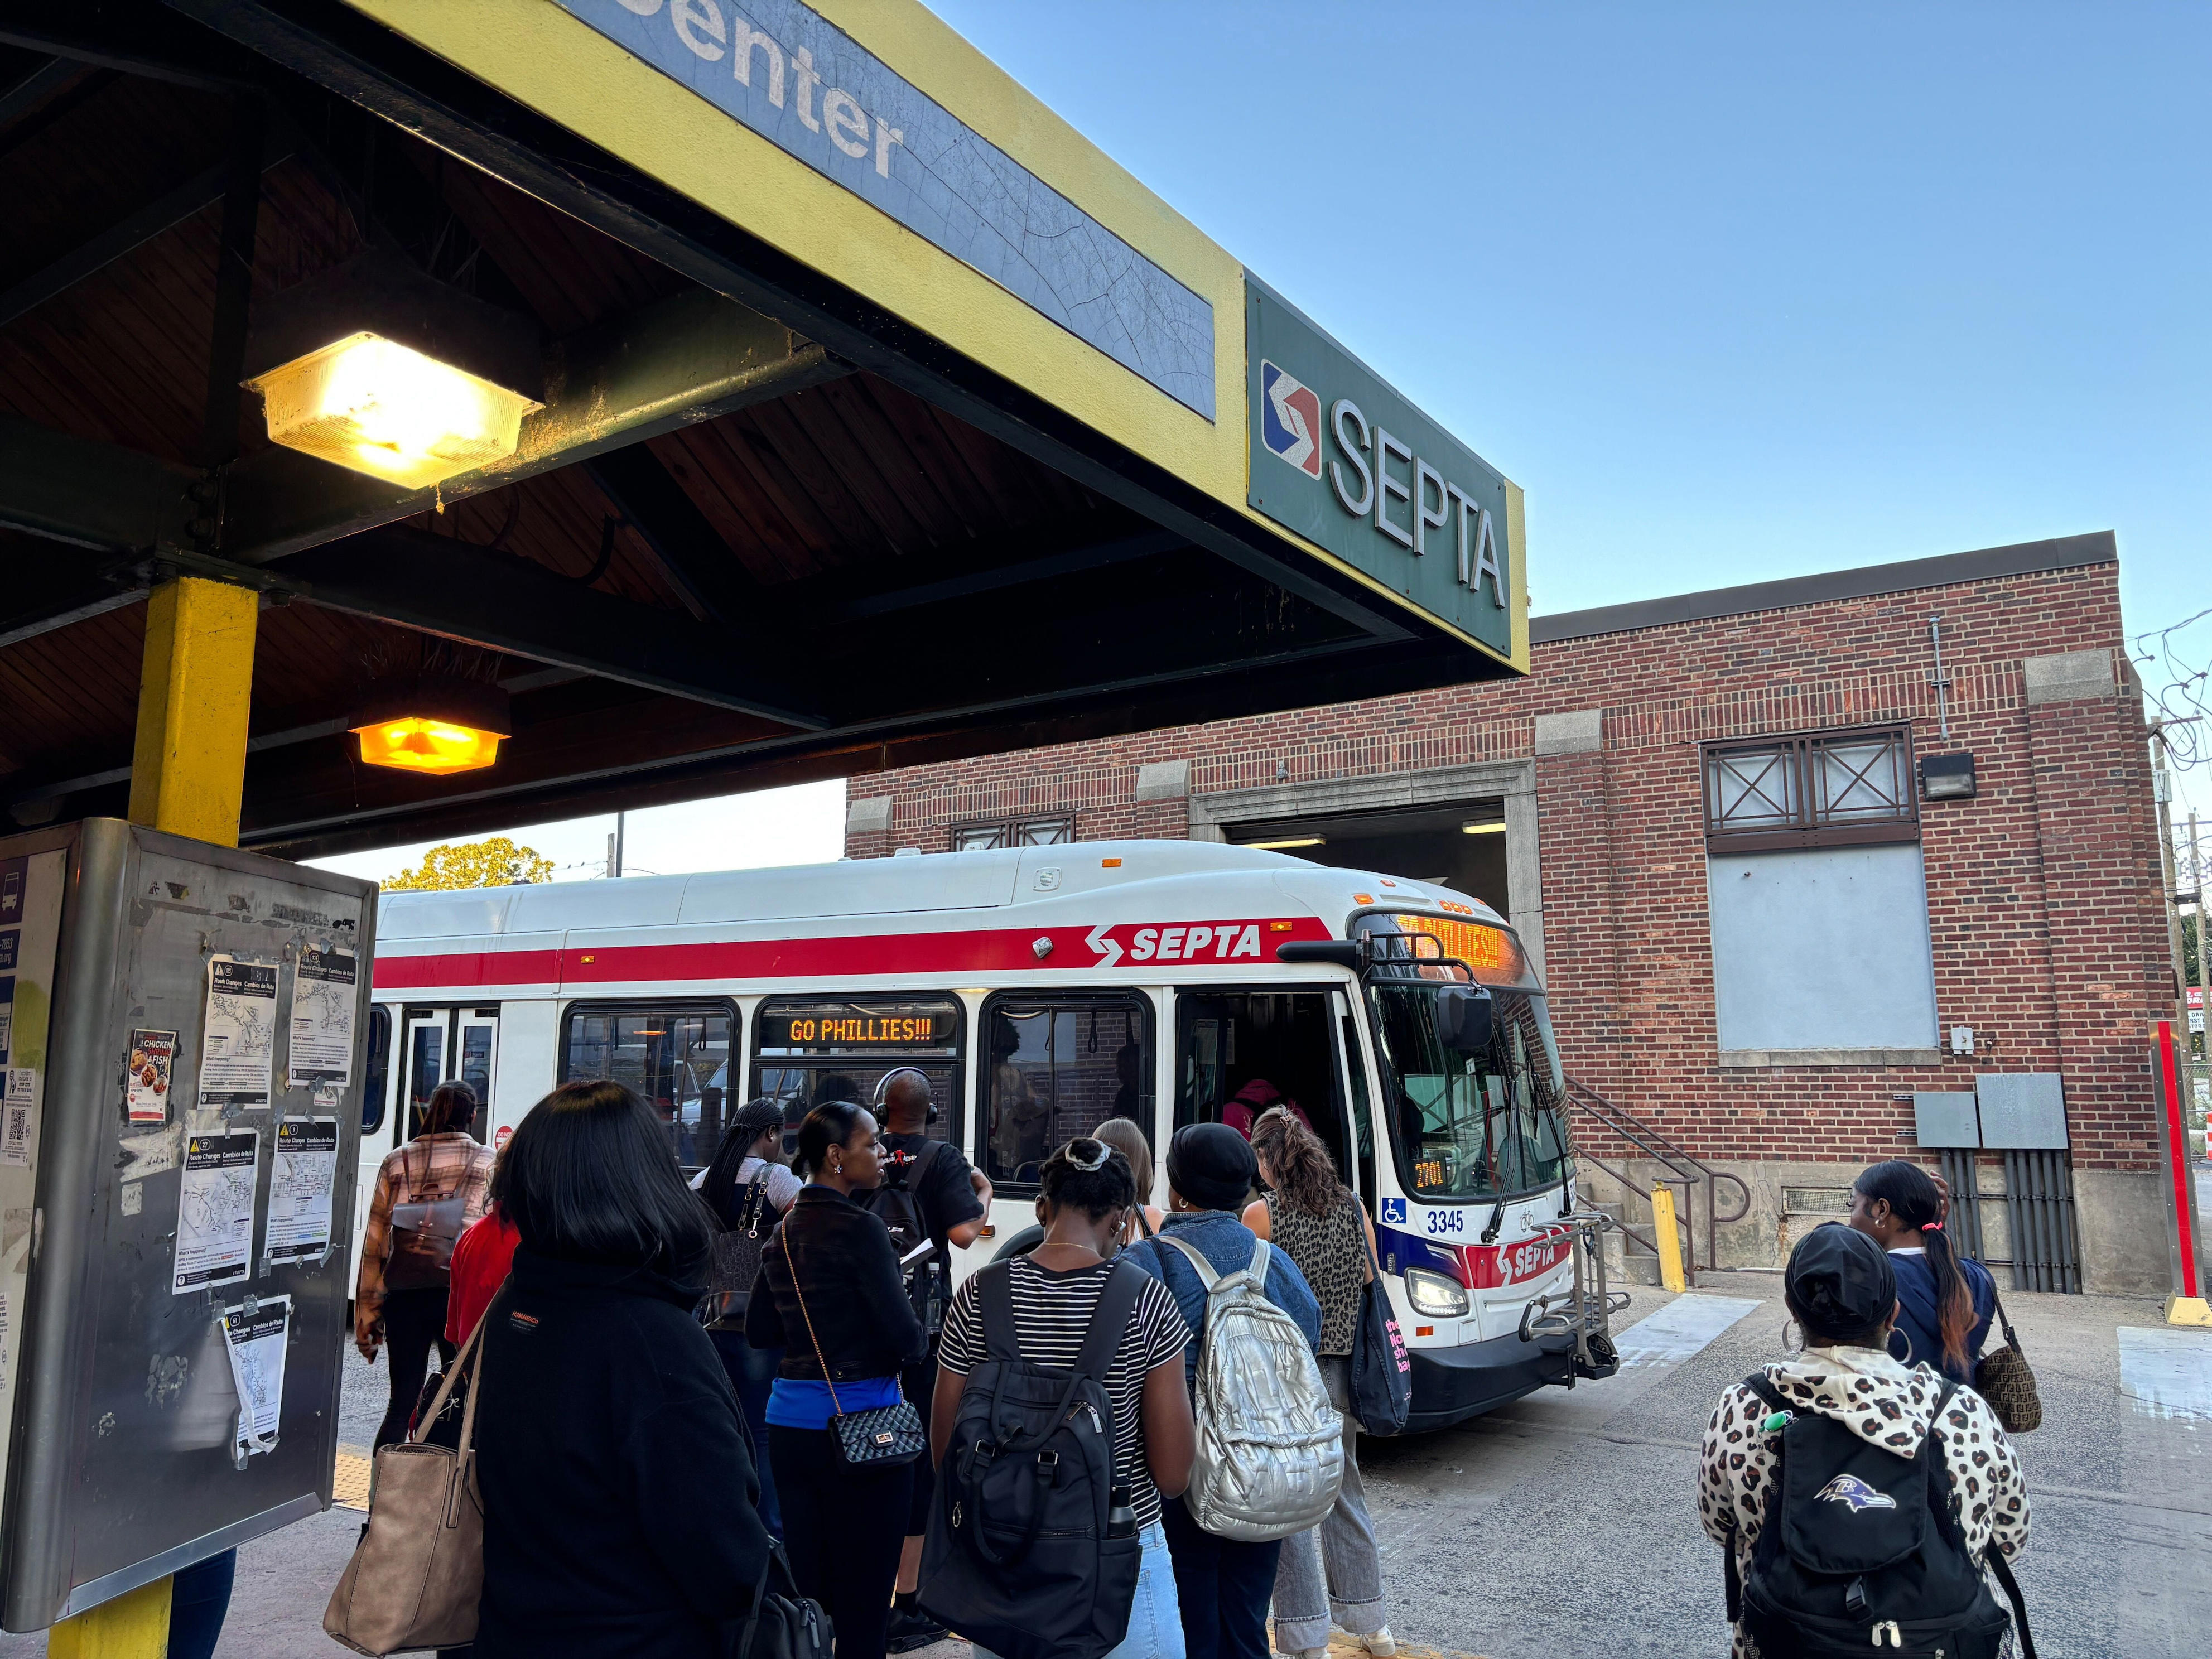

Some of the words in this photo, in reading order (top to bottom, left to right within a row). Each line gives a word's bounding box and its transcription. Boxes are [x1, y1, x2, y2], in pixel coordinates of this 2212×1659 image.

[616, 0, 904, 179] enter
[1329, 399, 1505, 609] SEPTA
[1130, 925, 1260, 961] SEPTA
[791, 1020, 815, 1041] GO
[821, 1019, 931, 1040] PHILLIES!!!
[144, 1040, 172, 1049] CHICKEN
[152, 1055, 168, 1065] FISH
[1415, 1161, 1443, 1188] 2701
[1428, 1210, 1463, 1233] 3345
[1515, 1245, 1554, 1277] SEPTA
[253, 1322, 268, 1330] Cambios
